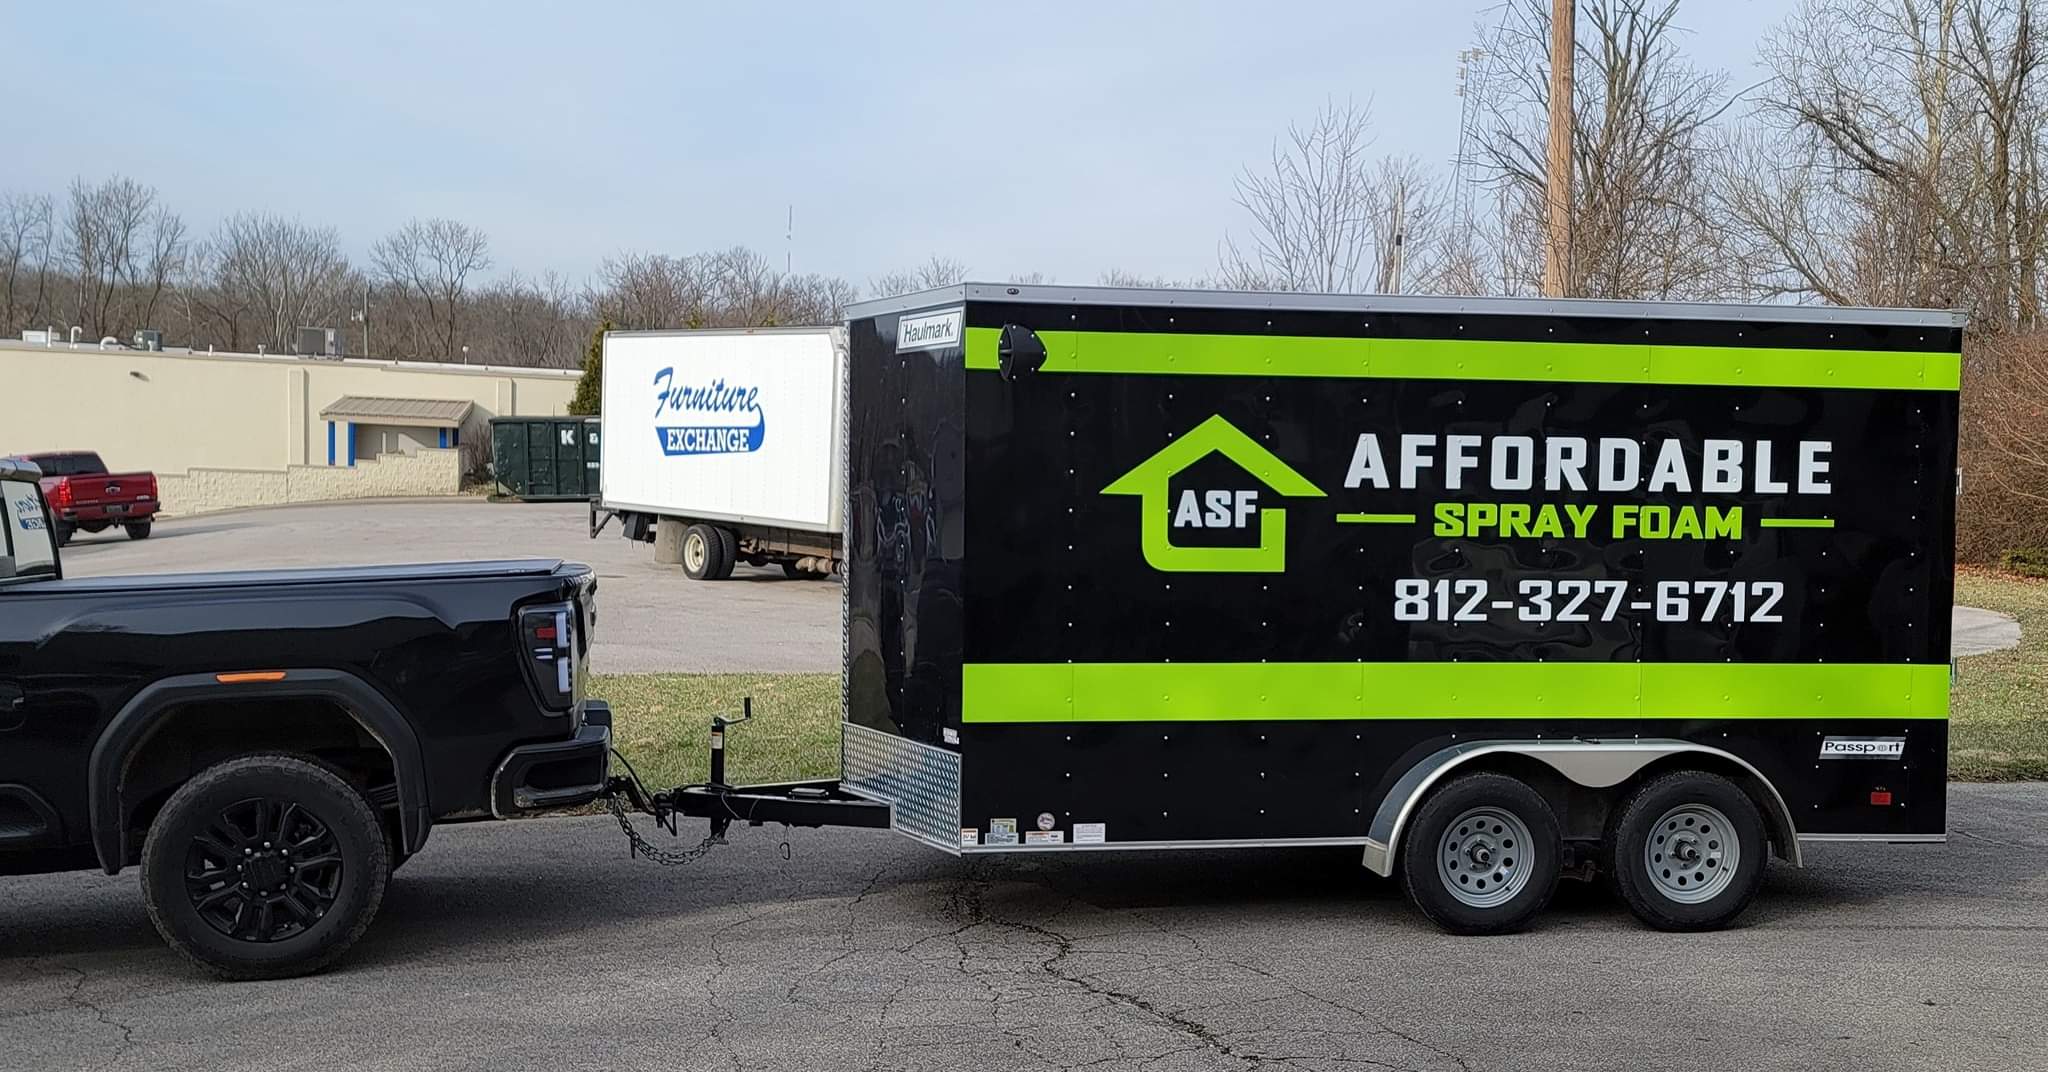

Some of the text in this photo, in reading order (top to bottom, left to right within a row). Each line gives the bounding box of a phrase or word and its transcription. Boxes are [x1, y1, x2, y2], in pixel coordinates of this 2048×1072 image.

[904, 318, 953, 342] Haulmark
[653, 366, 760, 418] Furniture
[561, 430, 575, 445] K
[667, 428, 750, 452] EXCHANGE
[1343, 433, 1832, 494] AFFORDABLE
[1173, 489, 1258, 528] ASF
[1434, 502, 1743, 540] SPRAY FOAM
[1394, 579, 1784, 623] 812-327-6712
[1824, 741, 1900, 754] Passport
